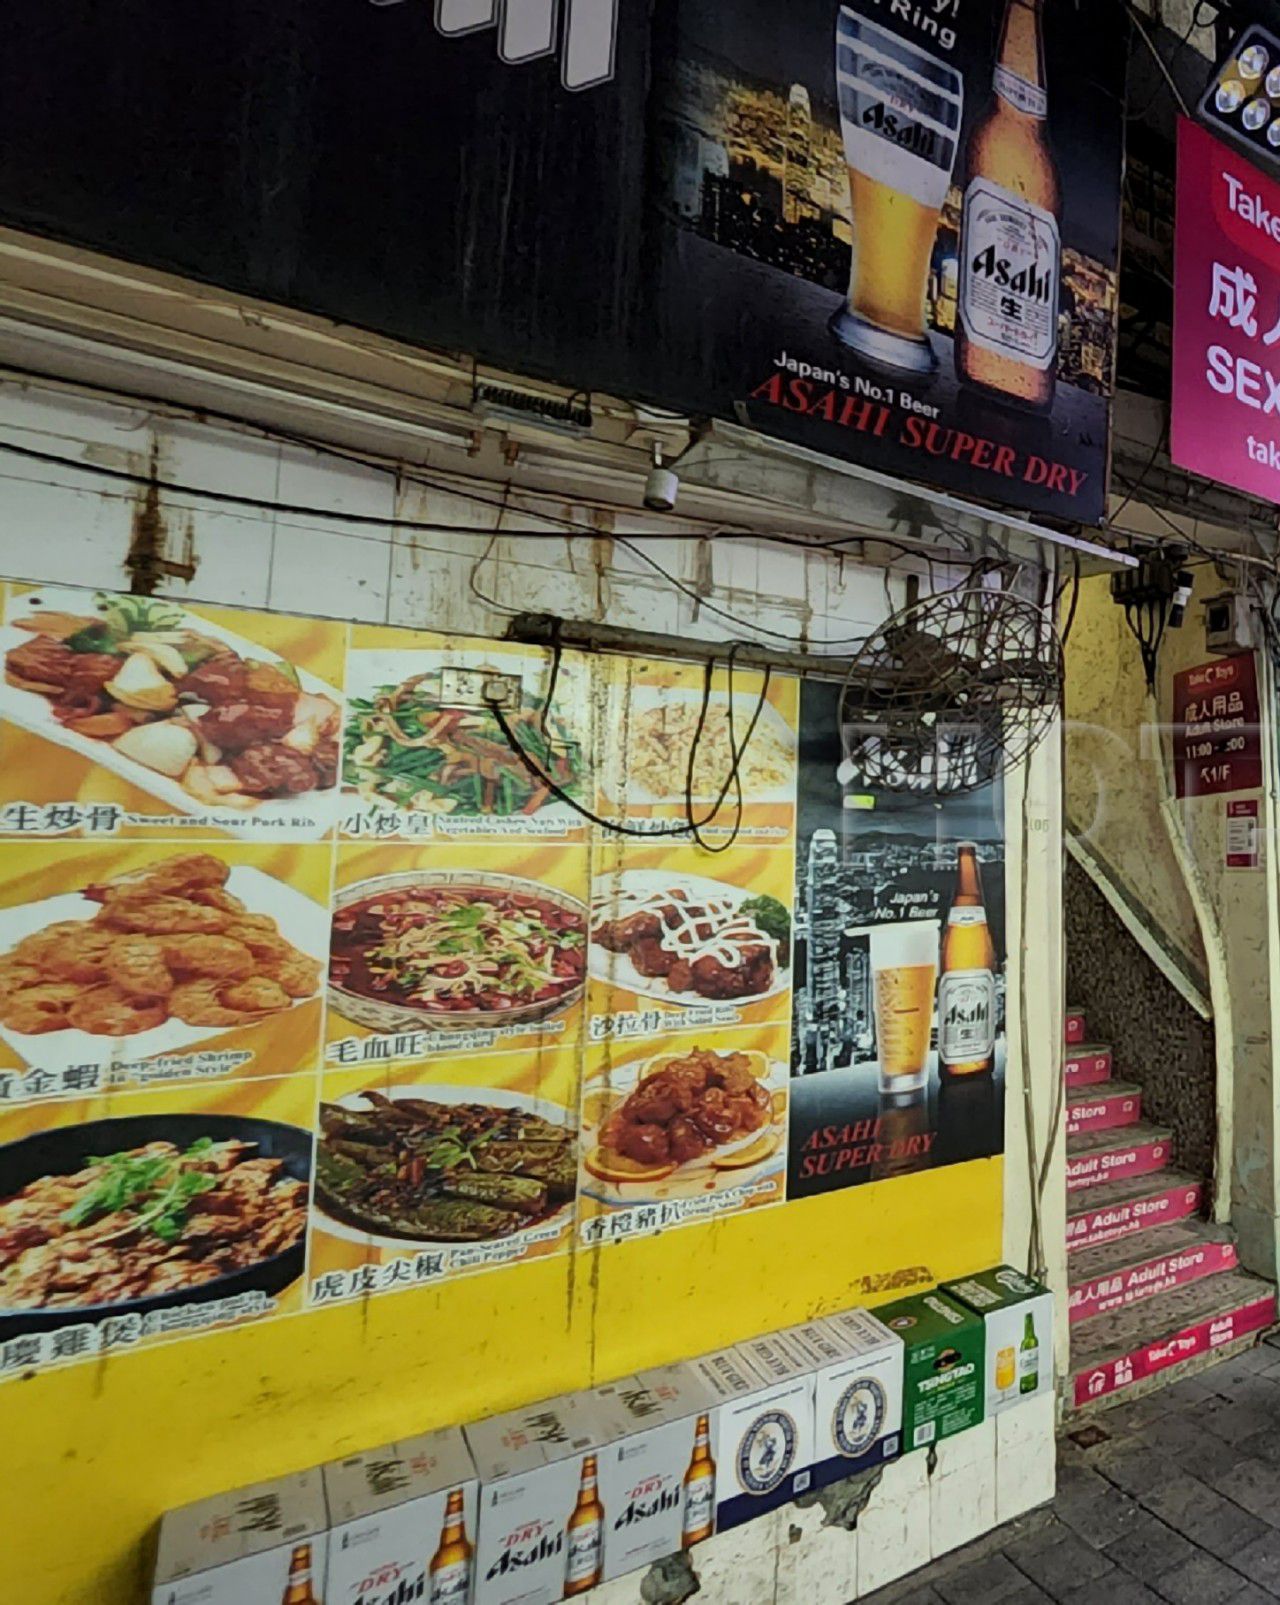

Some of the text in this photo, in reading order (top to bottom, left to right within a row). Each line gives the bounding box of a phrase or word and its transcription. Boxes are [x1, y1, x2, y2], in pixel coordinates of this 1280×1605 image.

[972, 244, 1051, 304] Asahi
[1000, 297, 1022, 322] 生
[774, 351, 941, 420] Japan's No.1 Beer
[750, 373, 1090, 497] ASAHI SUPER DRY
[1184, 691, 1244, 723] 成人用品
[4, 804, 119, 832] 生炒骨
[889, 889, 940, 905] Japan's
[1071, 1105, 1106, 1120] Store
[801, 1117, 882, 1150] ASAHI
[799, 1143, 884, 1179] SUPER
[1101, 1152, 1136, 1169] Store
[1091, 1207, 1131, 1229] Adult
[1131, 1199, 1169, 1217] Store
[312, 1252, 444, 1302] 虎皮尖椒
[1127, 1262, 1167, 1287] Adult
[1167, 1252, 1205, 1273] Store
[614, 1483, 681, 1531] Asahi
[485, 1528, 564, 1582] Asahi
